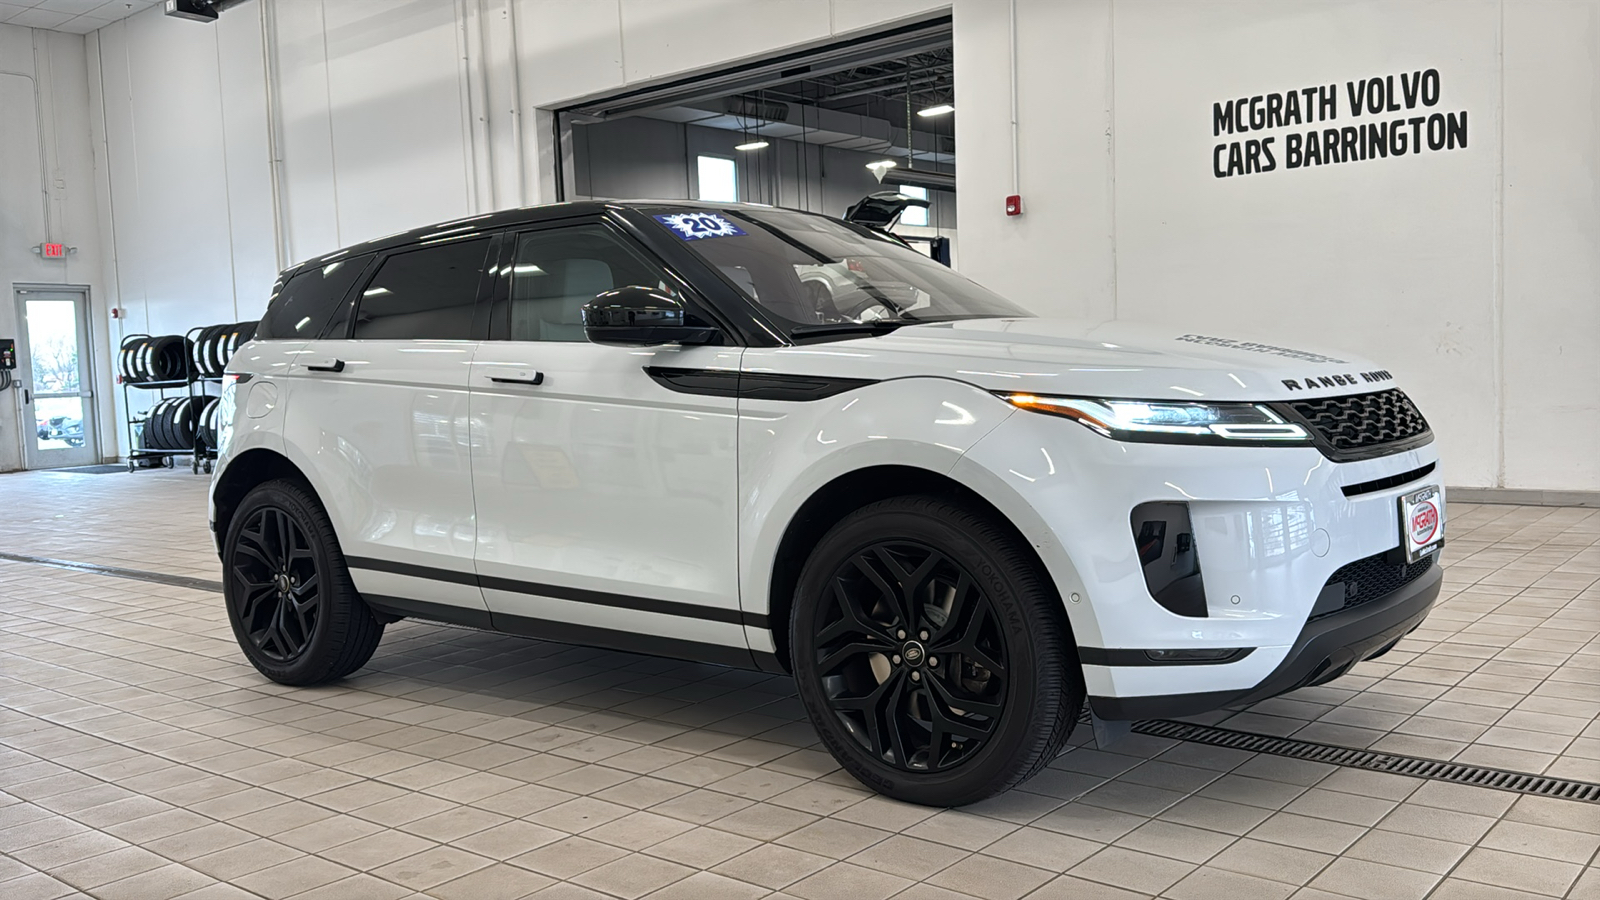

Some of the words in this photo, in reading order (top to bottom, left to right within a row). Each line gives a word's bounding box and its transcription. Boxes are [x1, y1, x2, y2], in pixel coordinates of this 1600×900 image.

[1213, 84, 1337, 136] MCGRATH
[1346, 68, 1440, 117] VOLVO
[1213, 136, 1277, 178] CARS
[1286, 111, 1468, 169] BARRINGTON
[682, 216, 722, 233] 20
[45, 243, 63, 257] EXIT
[1280, 373, 1358, 391] RANGE
[975, 558, 1023, 636] YOKOHAMA
